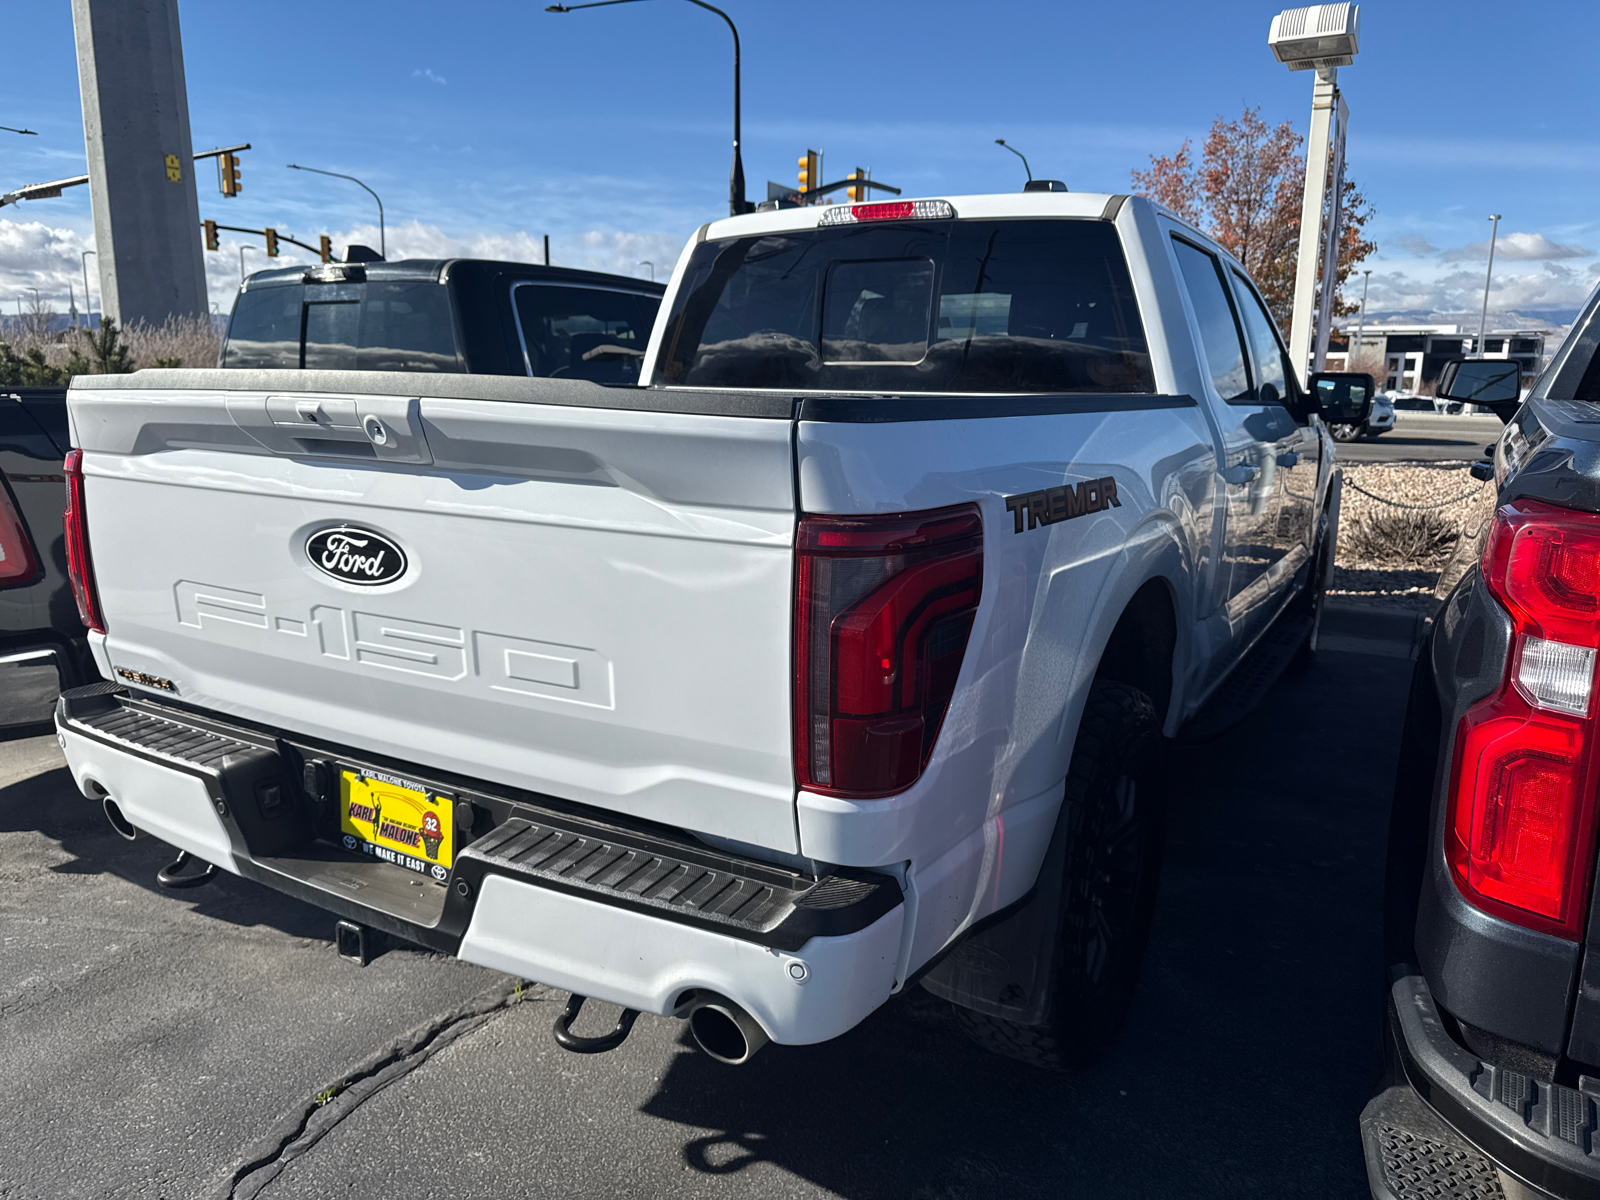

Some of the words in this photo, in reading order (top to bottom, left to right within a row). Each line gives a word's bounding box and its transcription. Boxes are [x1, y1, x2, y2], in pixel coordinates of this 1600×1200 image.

[1005, 476, 1122, 534] TREMOR
[321, 534, 385, 577] Ford
[173, 579, 615, 711] F-150
[361, 769, 378, 780] KARL
[378, 773, 402, 787] MALONE
[402, 780, 426, 793] TOYOTA
[349, 801, 374, 824] KARL
[425, 816, 437, 832] 32
[379, 822, 420, 847] MALONE
[363, 842, 374, 855] WE
[375, 846, 396, 863] MAKE
[397, 854, 404, 866] IT
[406, 857, 425, 873] EASY
